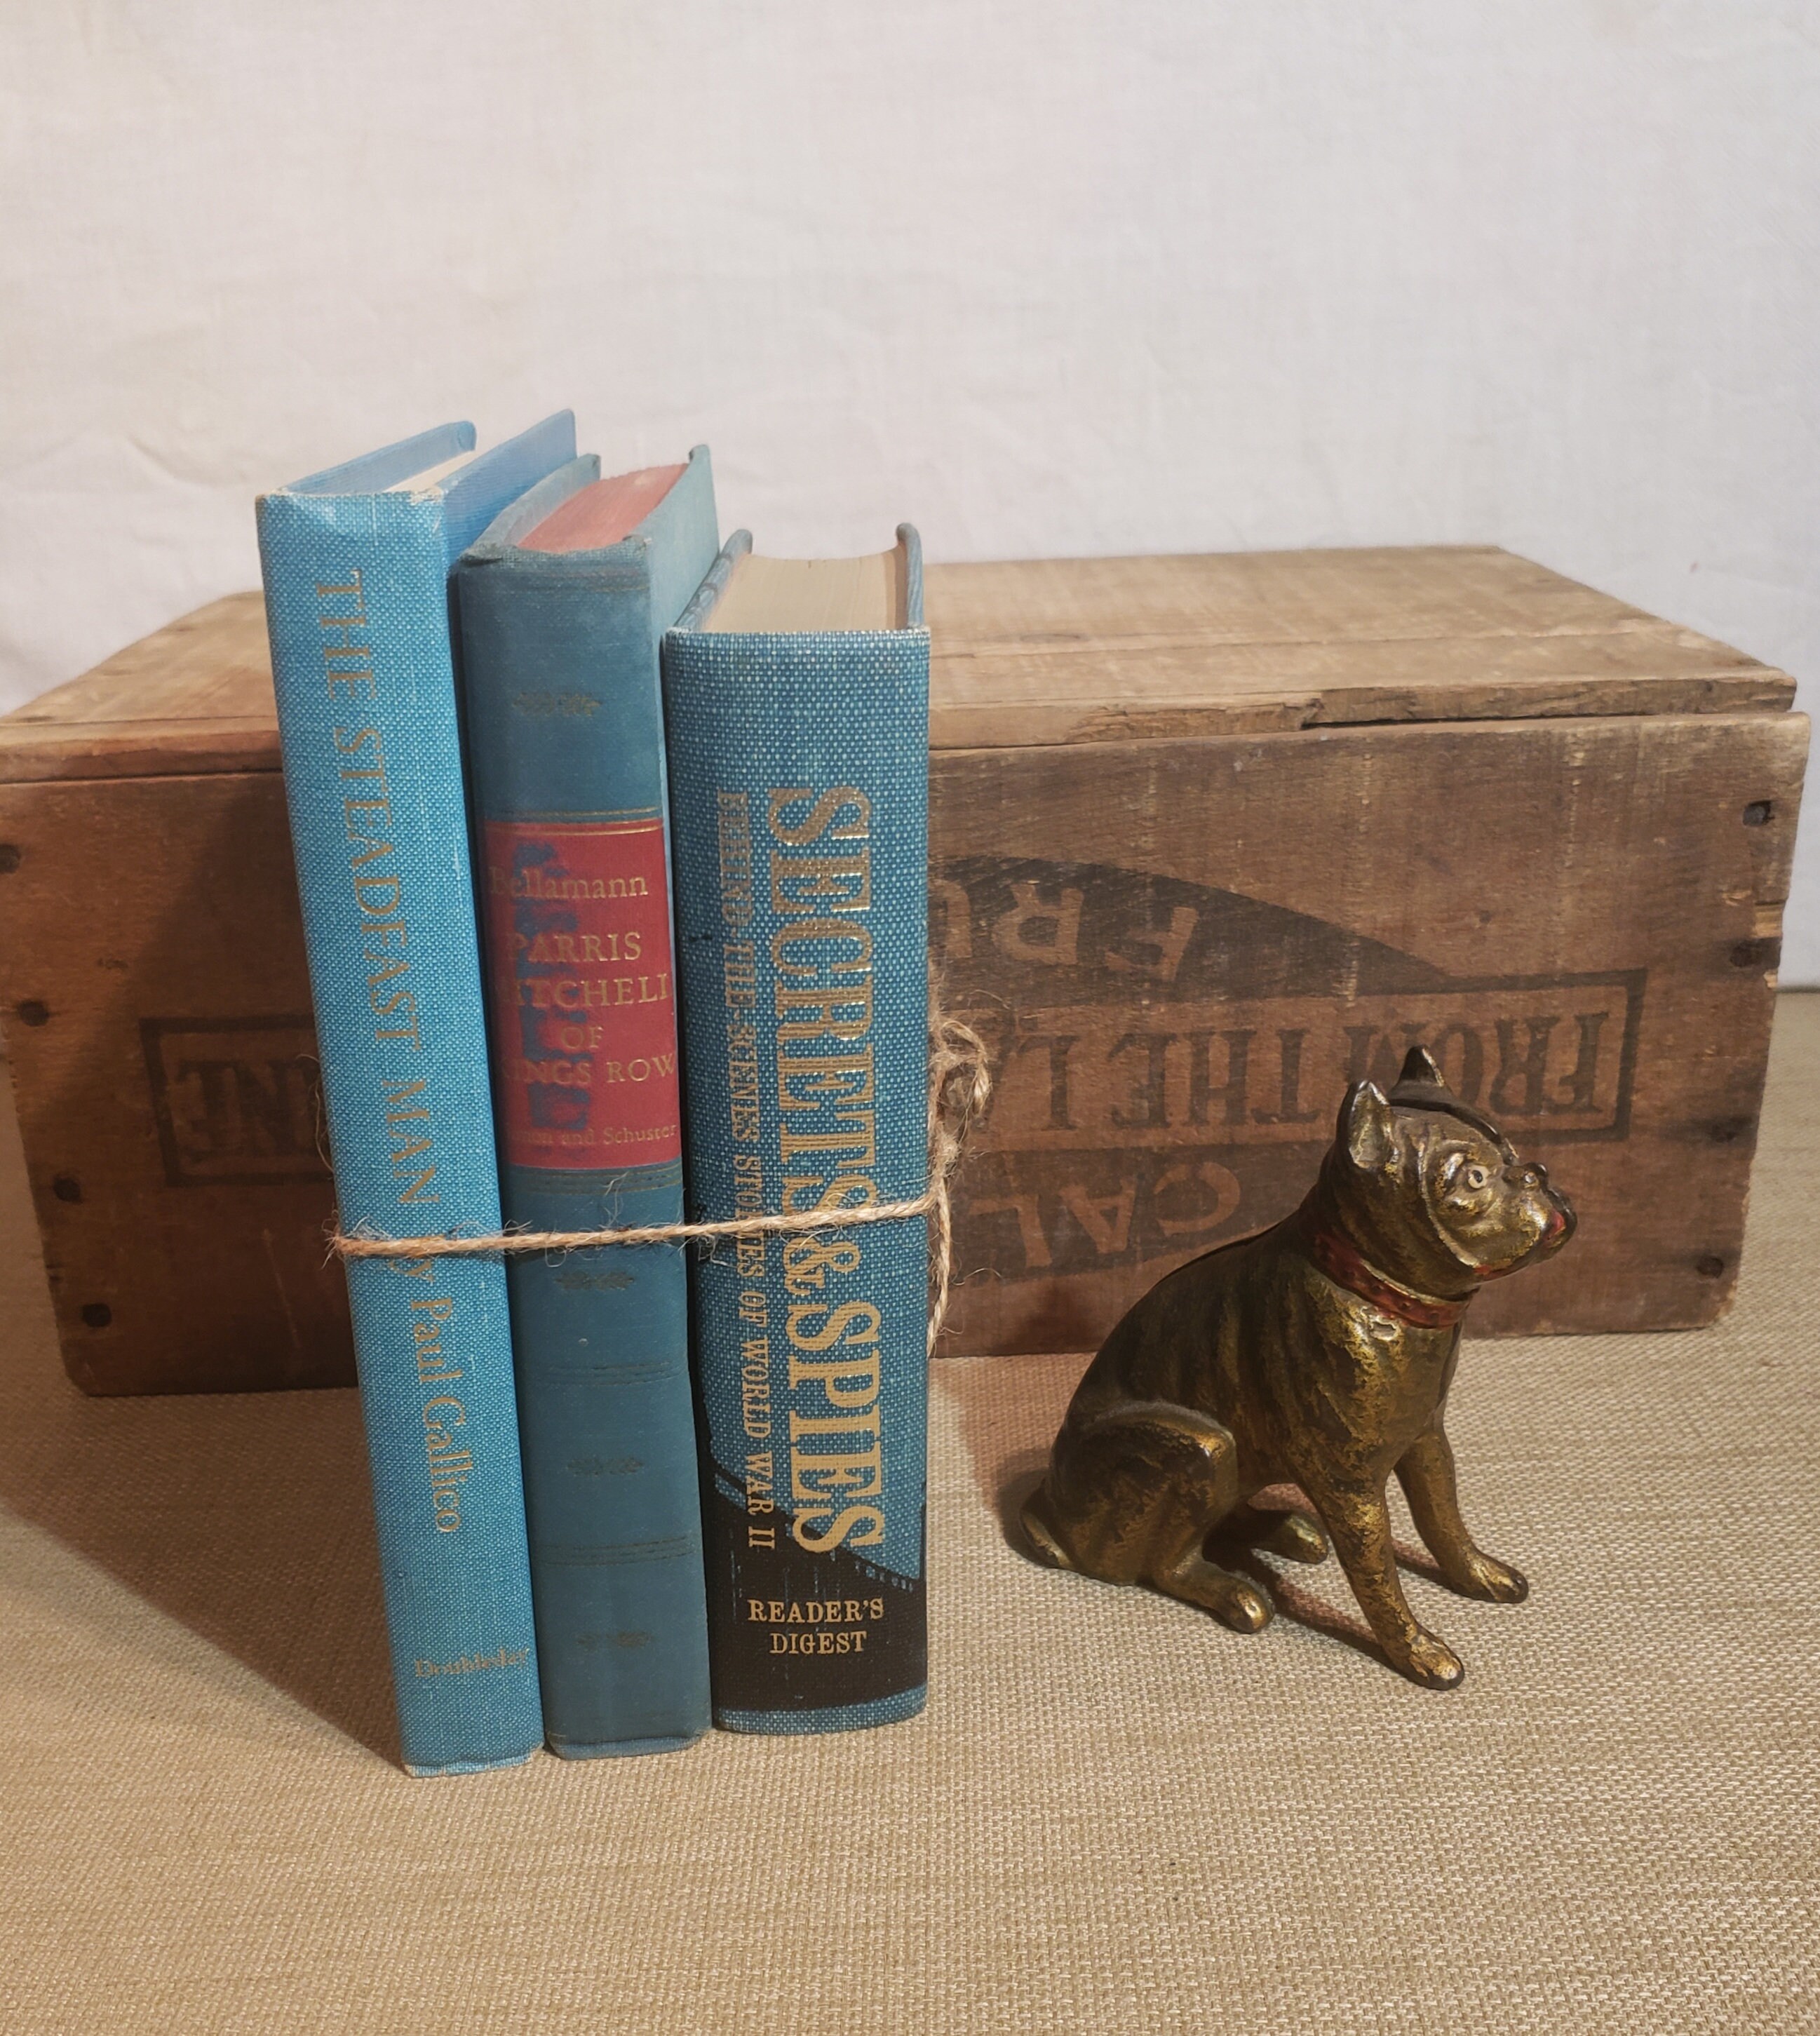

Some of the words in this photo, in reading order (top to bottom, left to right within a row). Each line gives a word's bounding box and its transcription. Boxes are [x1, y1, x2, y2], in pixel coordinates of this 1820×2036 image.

[316, 569, 377, 700] THE
[333, 727, 421, 1051] STEADFAST
[490, 865, 649, 899] Bellamann
[506, 931, 642, 963] PARRIS
[767, 786, 878, 1218] SECRETS
[560, 1027, 605, 1050] OF
[605, 1053, 676, 1084] ROW
[1108, 1028, 1323, 1131] THE
[381, 1079, 440, 1204] MAN
[602, 1124, 678, 1145] Schuster
[782, 1236, 861, 1296] &
[410, 1297, 464, 1384] Paul
[738, 1290, 769, 1328] OF
[740, 1337, 771, 1438] WORLD
[784, 1300, 885, 1553] SPIES
[422, 1396, 473, 1533] Gallico
[743, 1450, 776, 1516] WAR
[748, 1526, 776, 1550] II
[747, 1596, 885, 1624] READER'S
[769, 1630, 868, 1655] DIGEST
